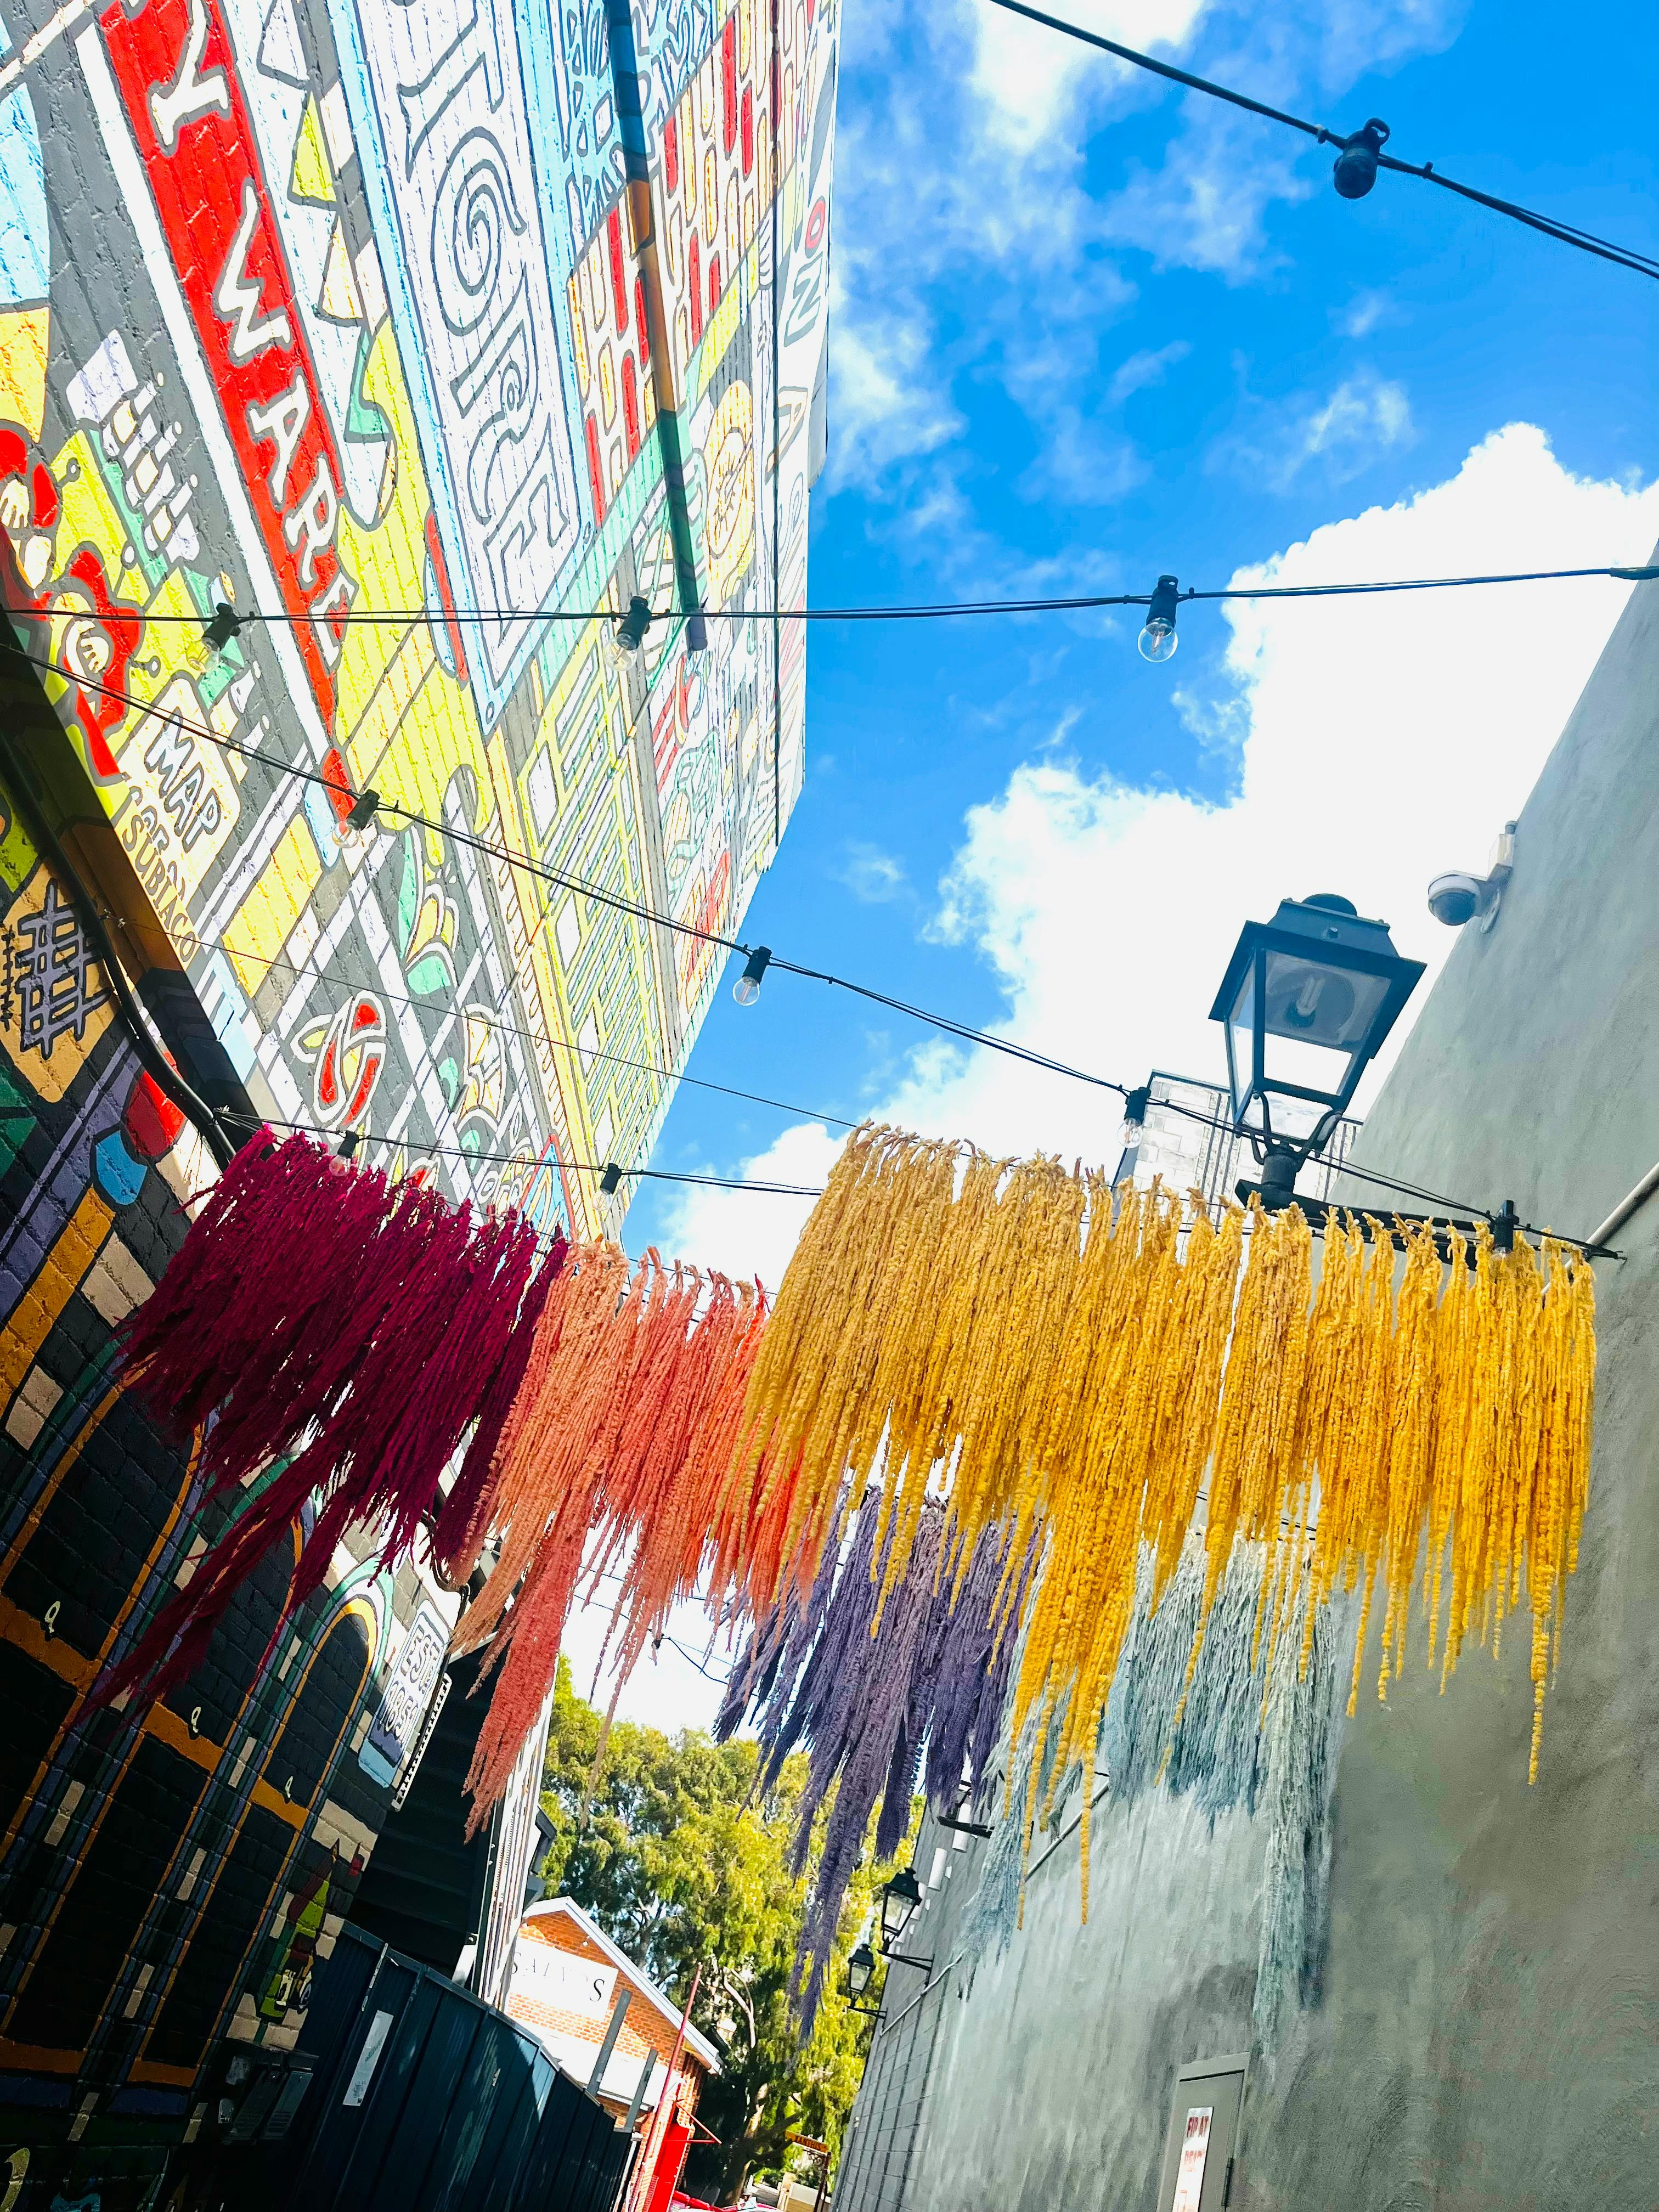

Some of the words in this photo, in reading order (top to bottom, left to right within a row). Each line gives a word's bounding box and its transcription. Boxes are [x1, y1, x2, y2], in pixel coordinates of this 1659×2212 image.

[391, 0, 568, 686] TORE
[784, 195, 825, 347] ON
[213, 178, 359, 674] WARE
[144, 706, 221, 853] MAP
[122, 815, 199, 962] SUBIACO
